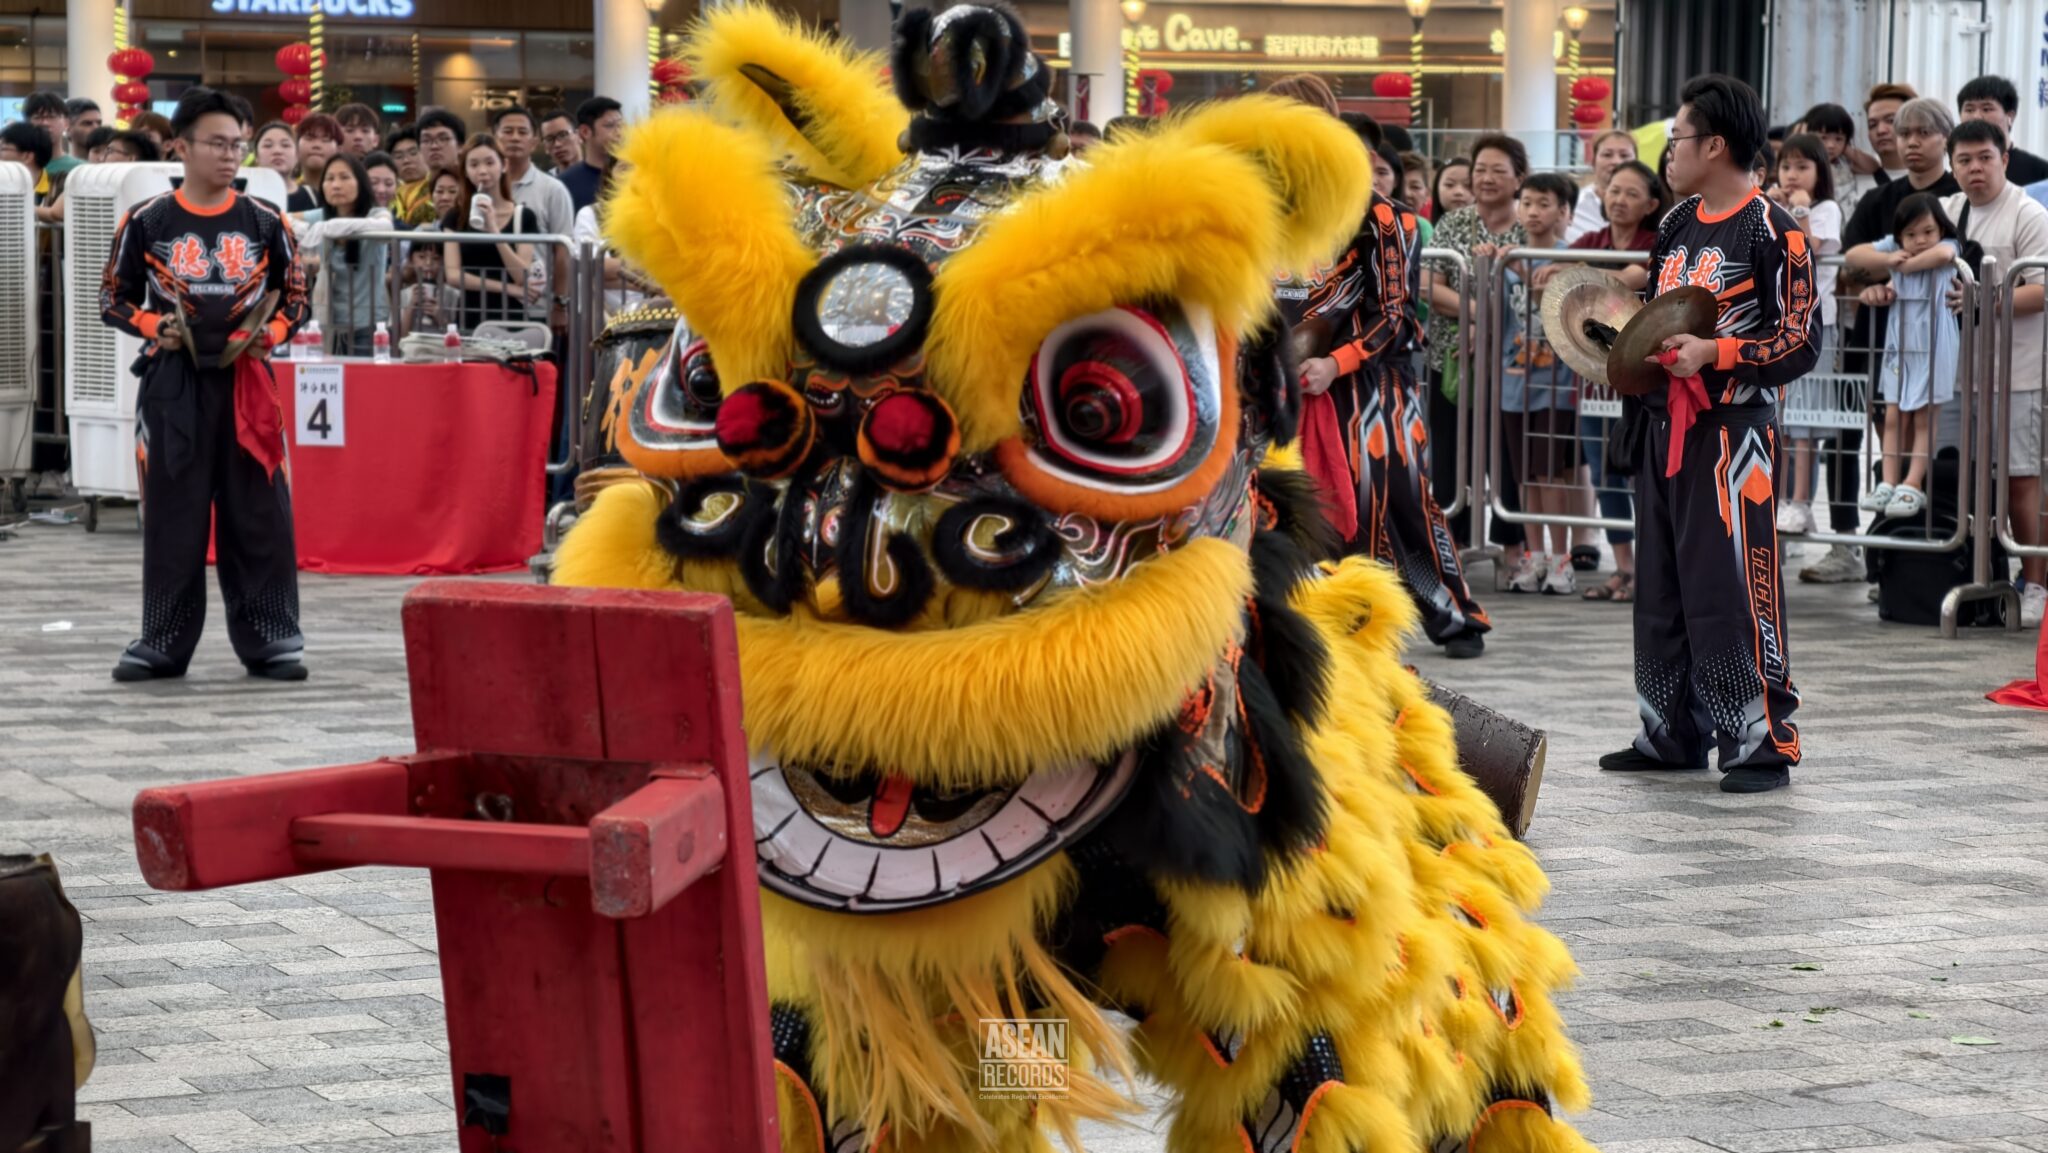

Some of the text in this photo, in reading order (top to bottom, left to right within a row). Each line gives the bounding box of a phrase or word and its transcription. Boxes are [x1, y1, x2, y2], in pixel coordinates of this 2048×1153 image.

[1583, 403, 1616, 412] BUKIT
[1786, 376, 1868, 413] PAVILION
[307, 398, 332, 440] 4
[1786, 412, 1821, 422] BUKIT
[1433, 524, 1459, 576] NGAI
[1752, 547, 1784, 683] TECK NGAI
